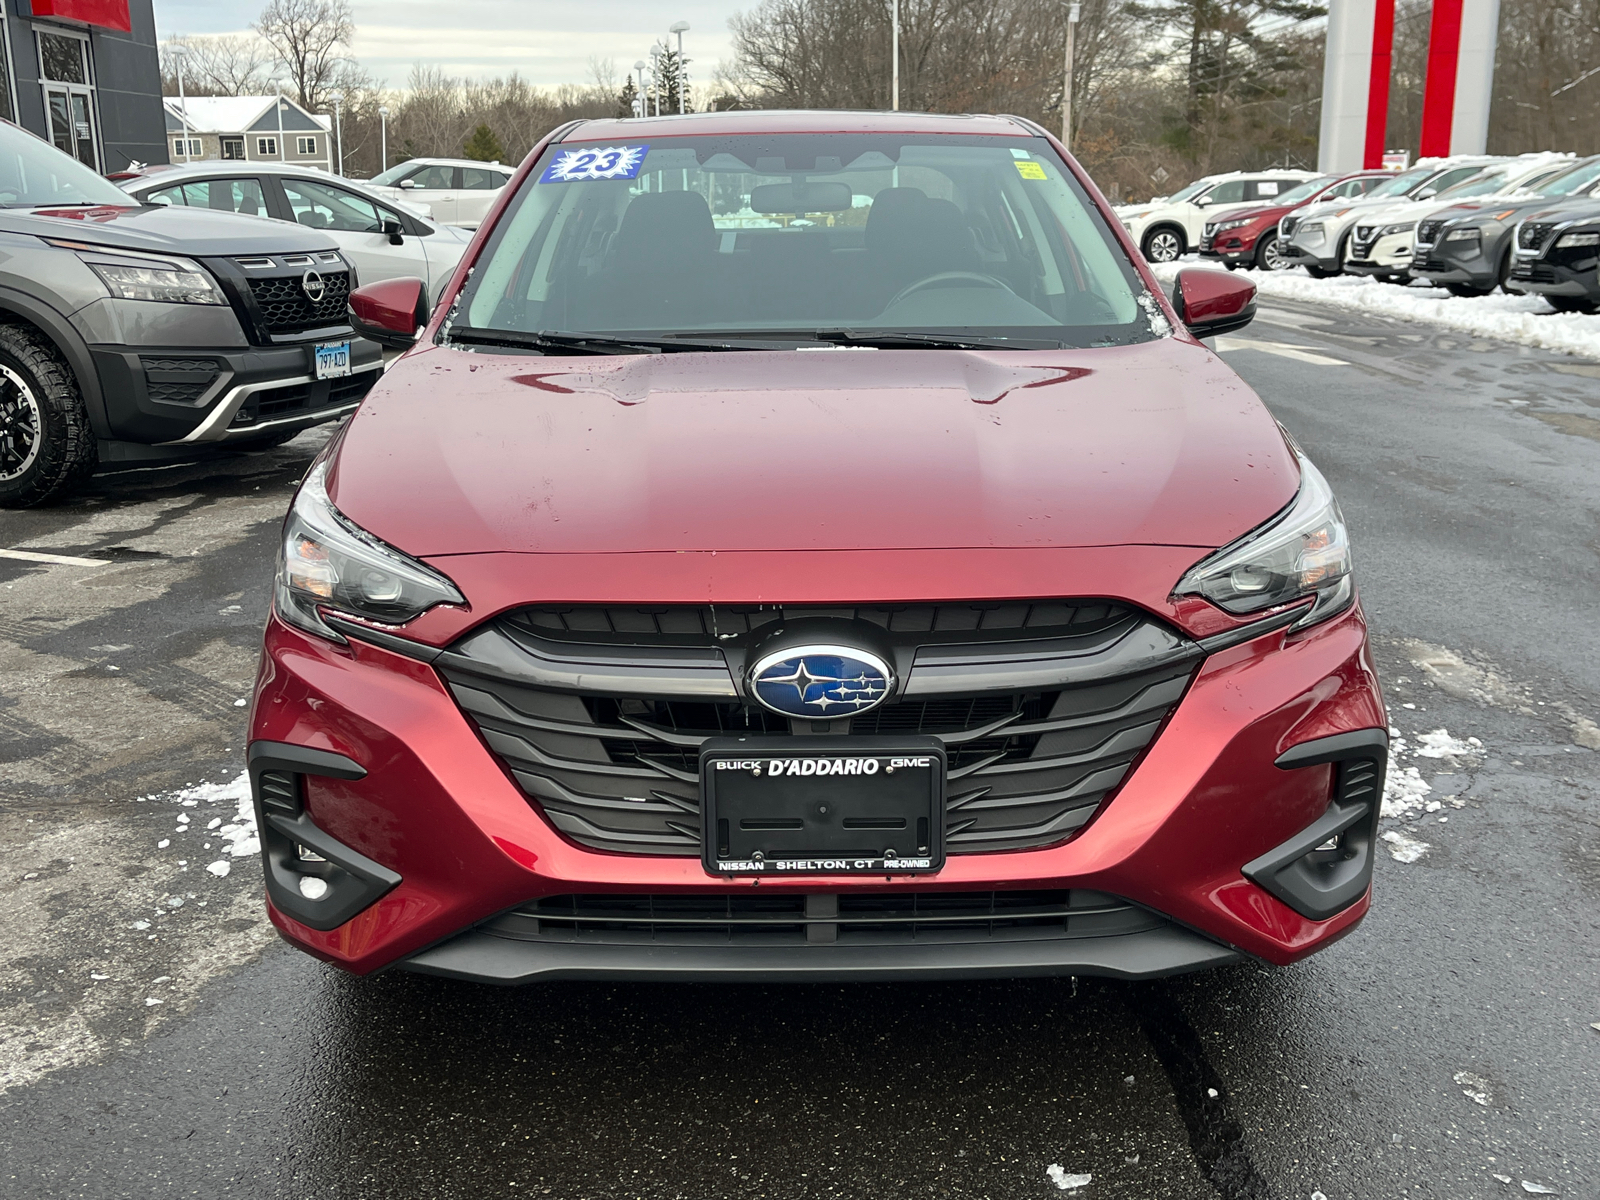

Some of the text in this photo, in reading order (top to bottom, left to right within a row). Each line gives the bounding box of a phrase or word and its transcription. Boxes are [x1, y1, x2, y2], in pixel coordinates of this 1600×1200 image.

[567, 152, 622, 174] 23
[716, 758, 931, 776] BUICK D'ADDARIO GMC
[718, 859, 931, 871] NISSAN SHELTON, CT PRE-OWNED
